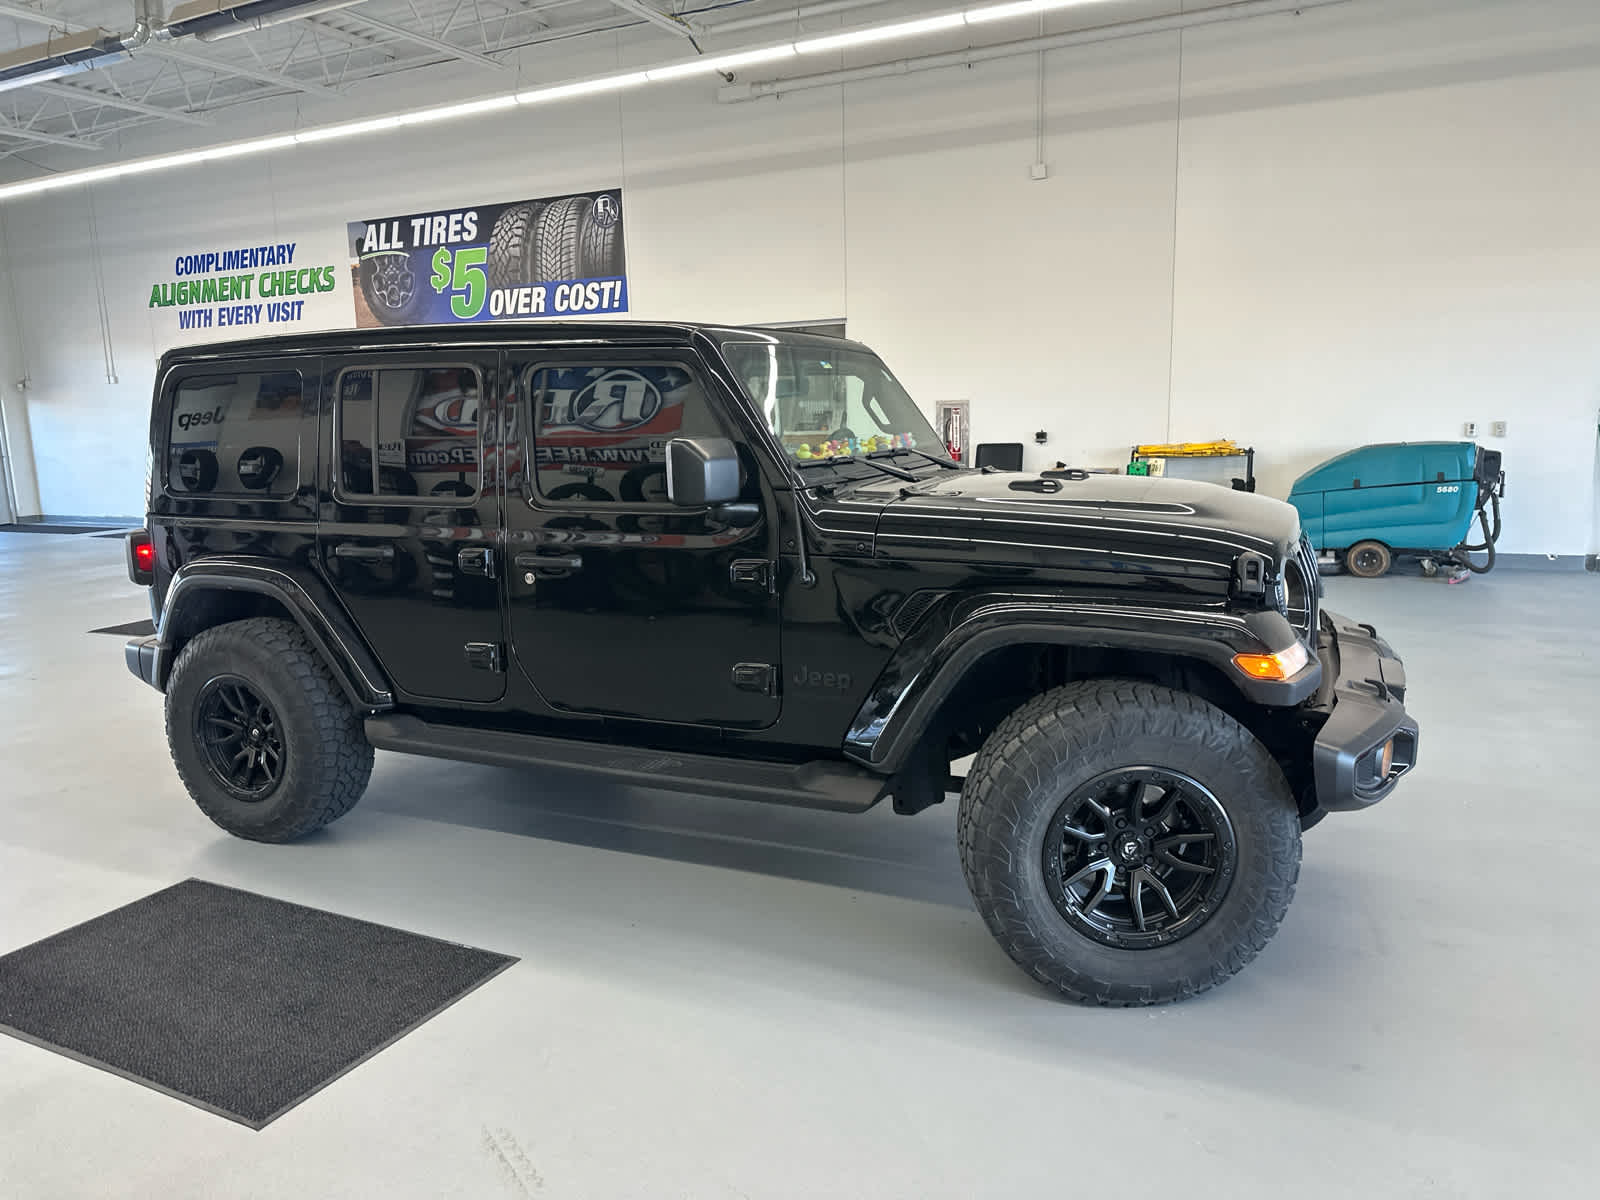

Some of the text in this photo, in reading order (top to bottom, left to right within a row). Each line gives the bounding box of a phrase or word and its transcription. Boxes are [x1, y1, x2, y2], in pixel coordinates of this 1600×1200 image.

[362, 210, 479, 252] ALL TIRES
[175, 243, 296, 276] COMPLIMENTARY
[149, 266, 336, 308] ALIGNMENT CHECKS
[430, 246, 488, 320] $5
[489, 280, 622, 316] OVER COST!
[179, 300, 305, 329] WITH EVERY VISIT
[1436, 485, 1459, 494] 5680
[793, 665, 854, 695] Jeep
